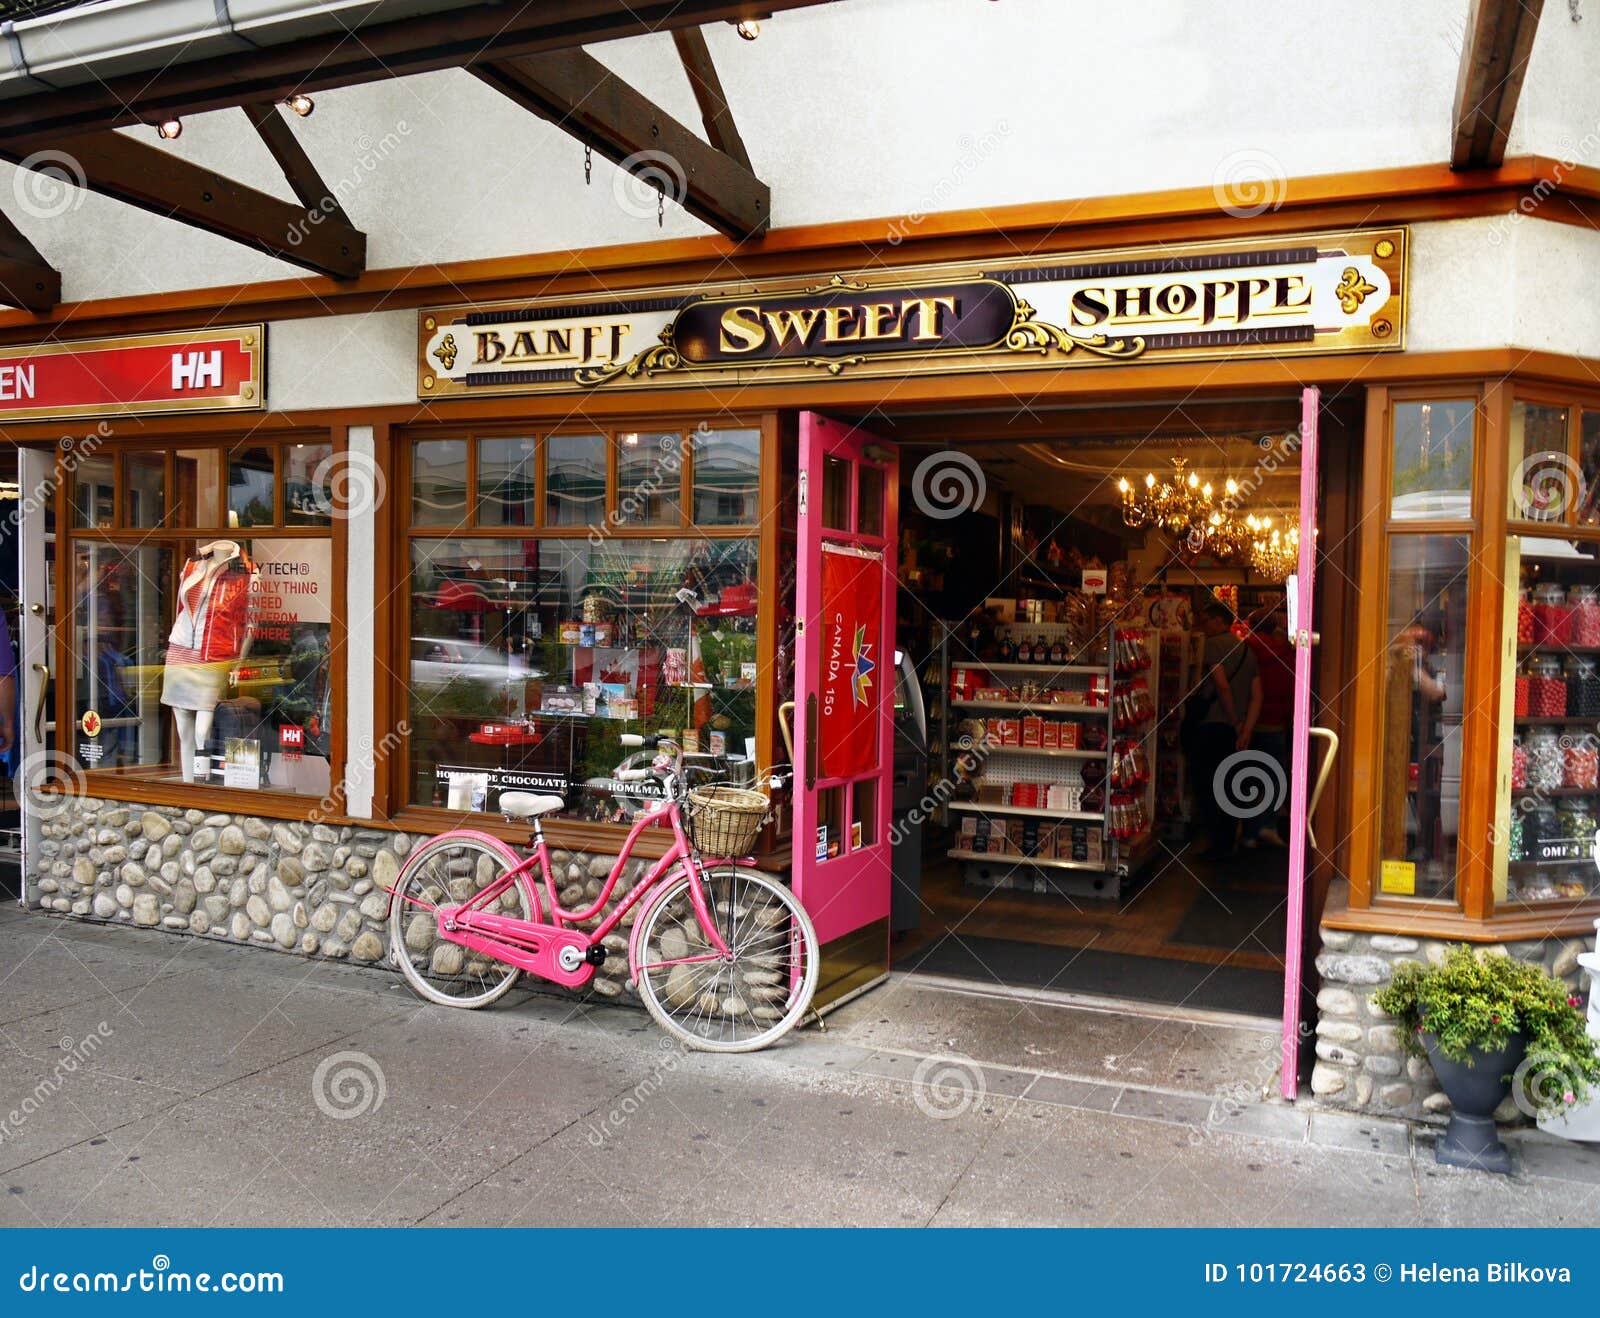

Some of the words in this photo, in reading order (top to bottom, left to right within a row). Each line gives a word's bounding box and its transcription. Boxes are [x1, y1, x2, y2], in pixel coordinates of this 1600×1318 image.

[472, 323, 632, 365] BANFF
[720, 296, 958, 352] SWEET
[1071, 276, 1312, 327] SHOPPE
[171, 350, 222, 389] HH
[252, 581, 280, 593] ONLY
[283, 582, 318, 594] THING
[252, 597, 282, 609] NEED
[266, 612, 298, 625] FROM
[828, 613, 842, 682] CANADA
[824, 688, 835, 716] 150
[283, 729, 301, 743] HH
[501, 775, 567, 788] CHOCOLATE
